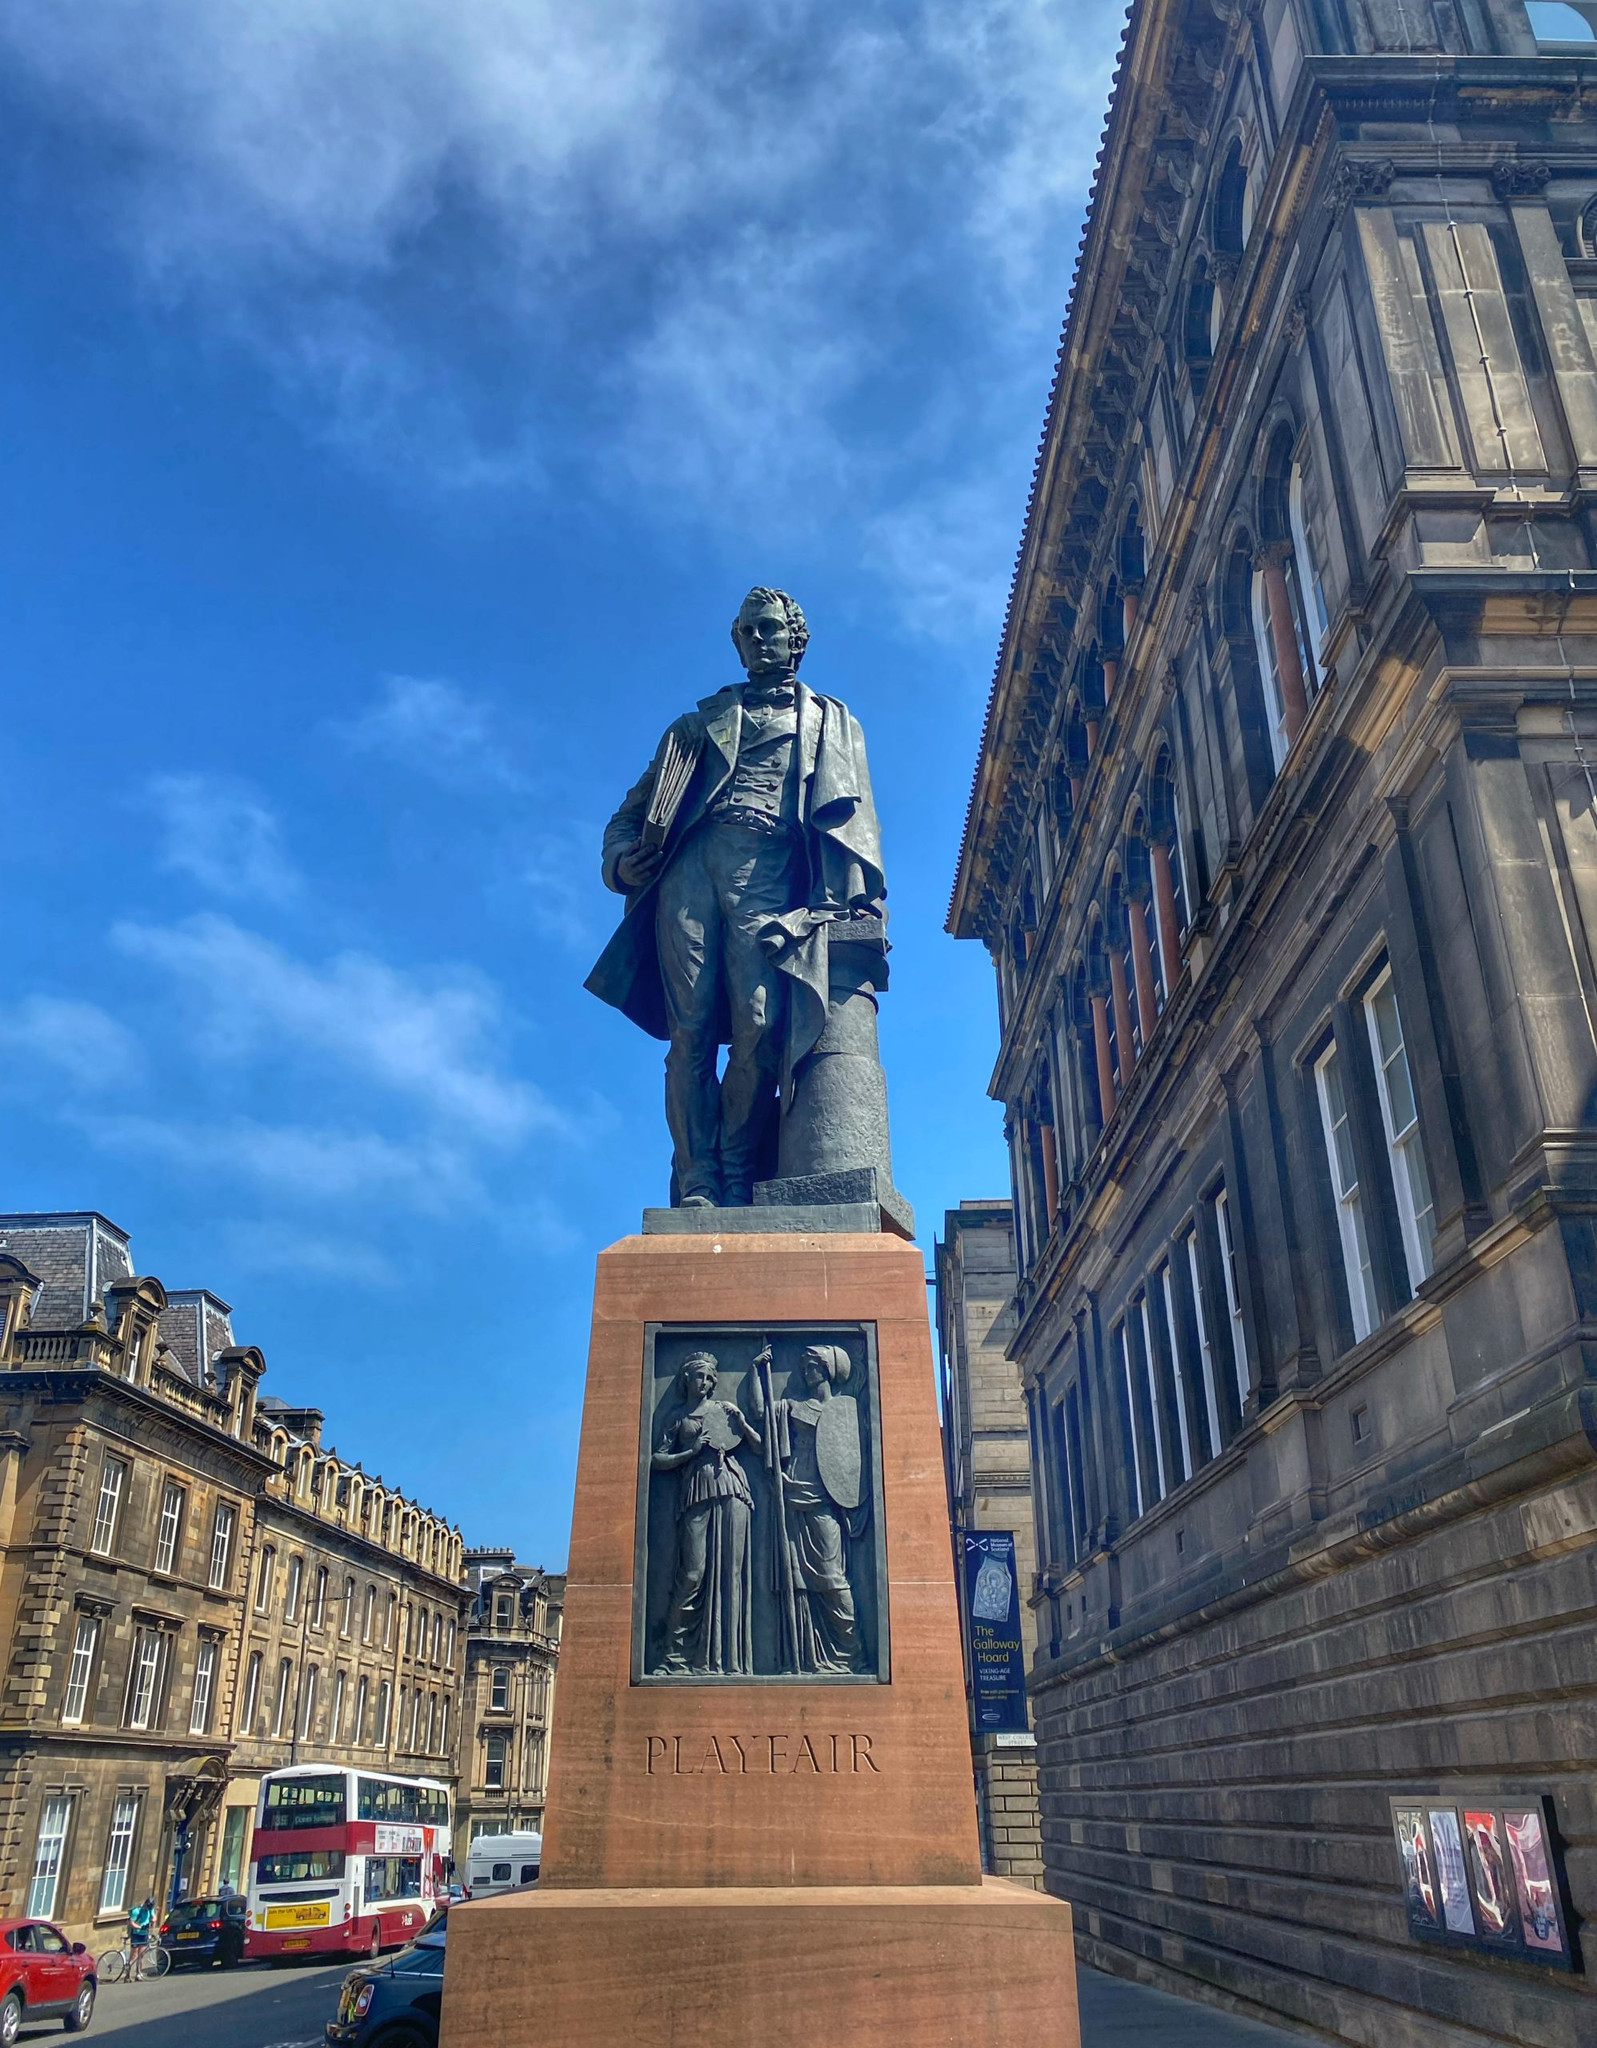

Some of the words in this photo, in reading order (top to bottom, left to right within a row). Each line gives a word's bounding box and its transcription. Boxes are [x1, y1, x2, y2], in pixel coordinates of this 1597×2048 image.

[975, 1625, 994, 1636] The
[973, 1638, 1020, 1651] Galloway
[977, 1651, 1009, 1663] Hoard
[643, 1734, 881, 1775] PLAYFAIR
